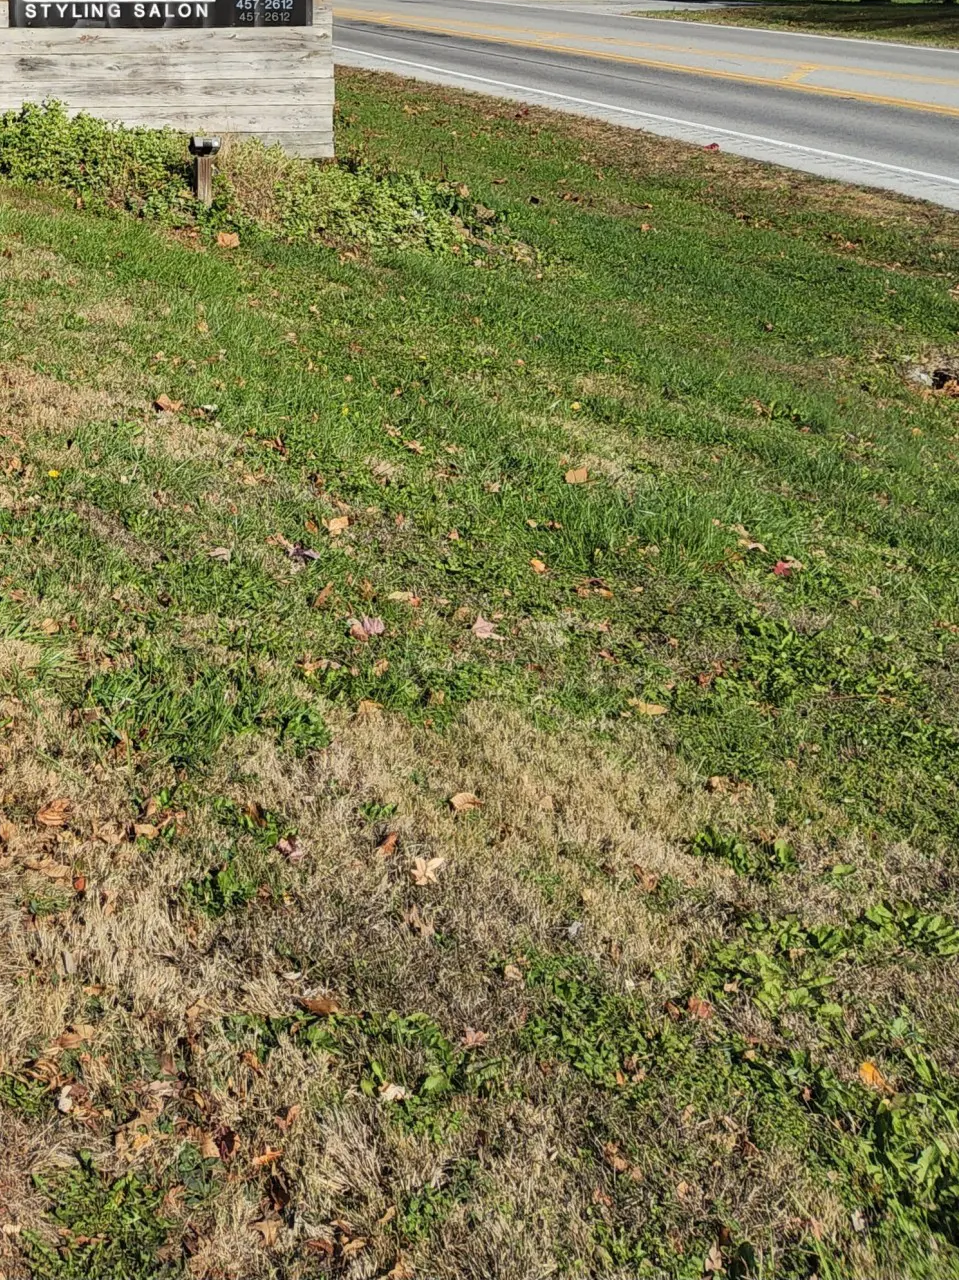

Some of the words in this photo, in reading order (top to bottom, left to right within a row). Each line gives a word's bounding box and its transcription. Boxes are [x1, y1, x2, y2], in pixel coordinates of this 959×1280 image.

[236, 0, 293, 10] 457-2612
[25, 3, 121, 18] STYLING
[133, 3, 209, 18] SALON
[239, 12, 290, 21] 457-2612
